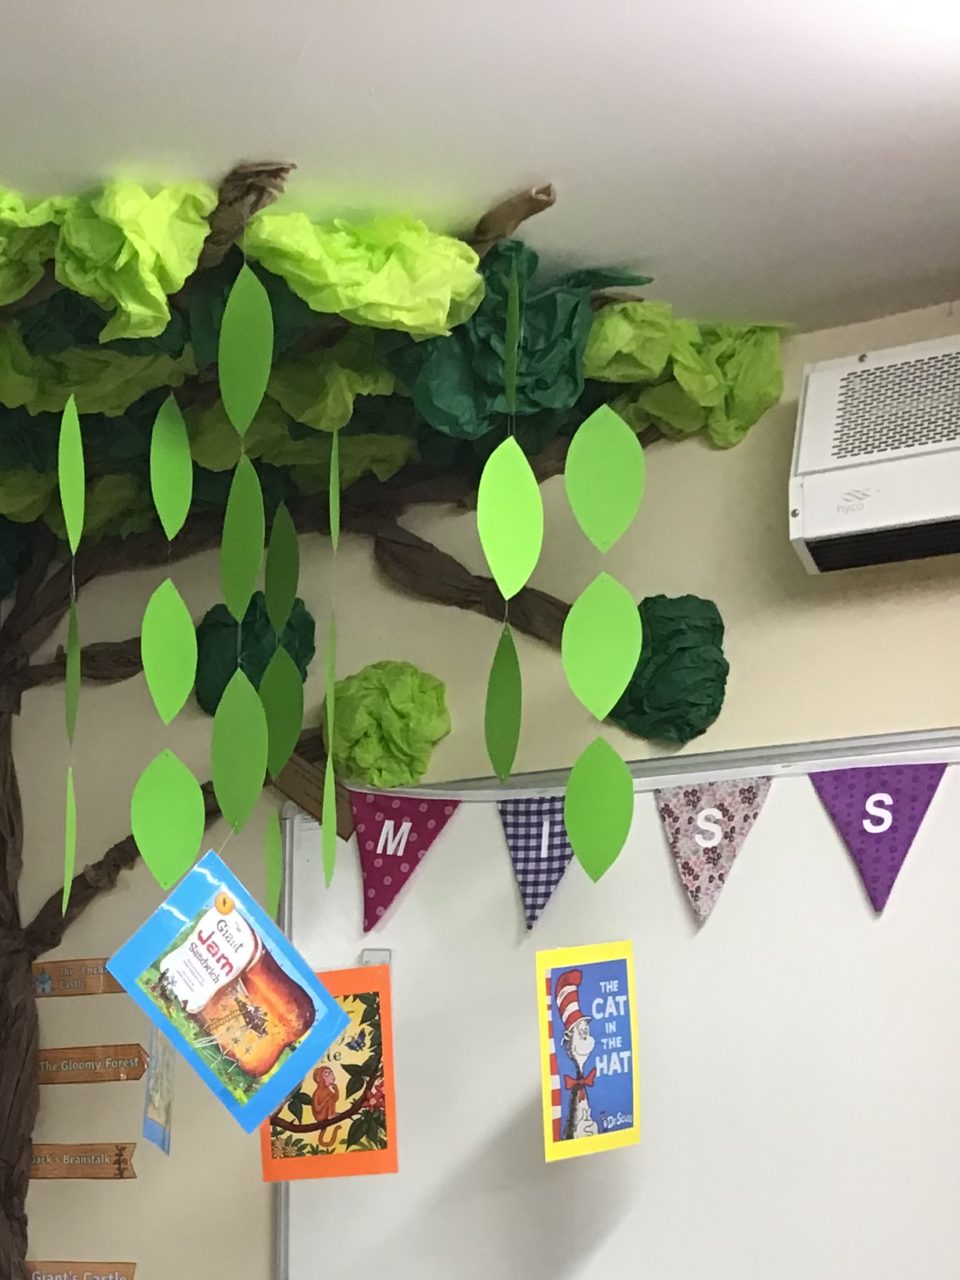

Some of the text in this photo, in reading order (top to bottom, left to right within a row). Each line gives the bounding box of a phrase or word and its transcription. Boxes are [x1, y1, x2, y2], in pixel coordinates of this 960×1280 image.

[376, 820, 414, 857] M
[694, 808, 724, 848] S
[862, 793, 894, 834] S
[216, 919, 244, 954] Giant
[188, 942, 220, 985] Sandwich
[197, 929, 234, 977] Jam
[599, 979, 619, 994] THE
[591, 994, 628, 1020] CAT
[604, 1020, 617, 1034] IN
[600, 1035, 622, 1051] THE
[60, 1058, 102, 1074] Gloomy
[104, 1056, 139, 1069] Forest
[594, 1050, 632, 1077] HAT
[62, 1153, 111, 1165] Beanstalk
